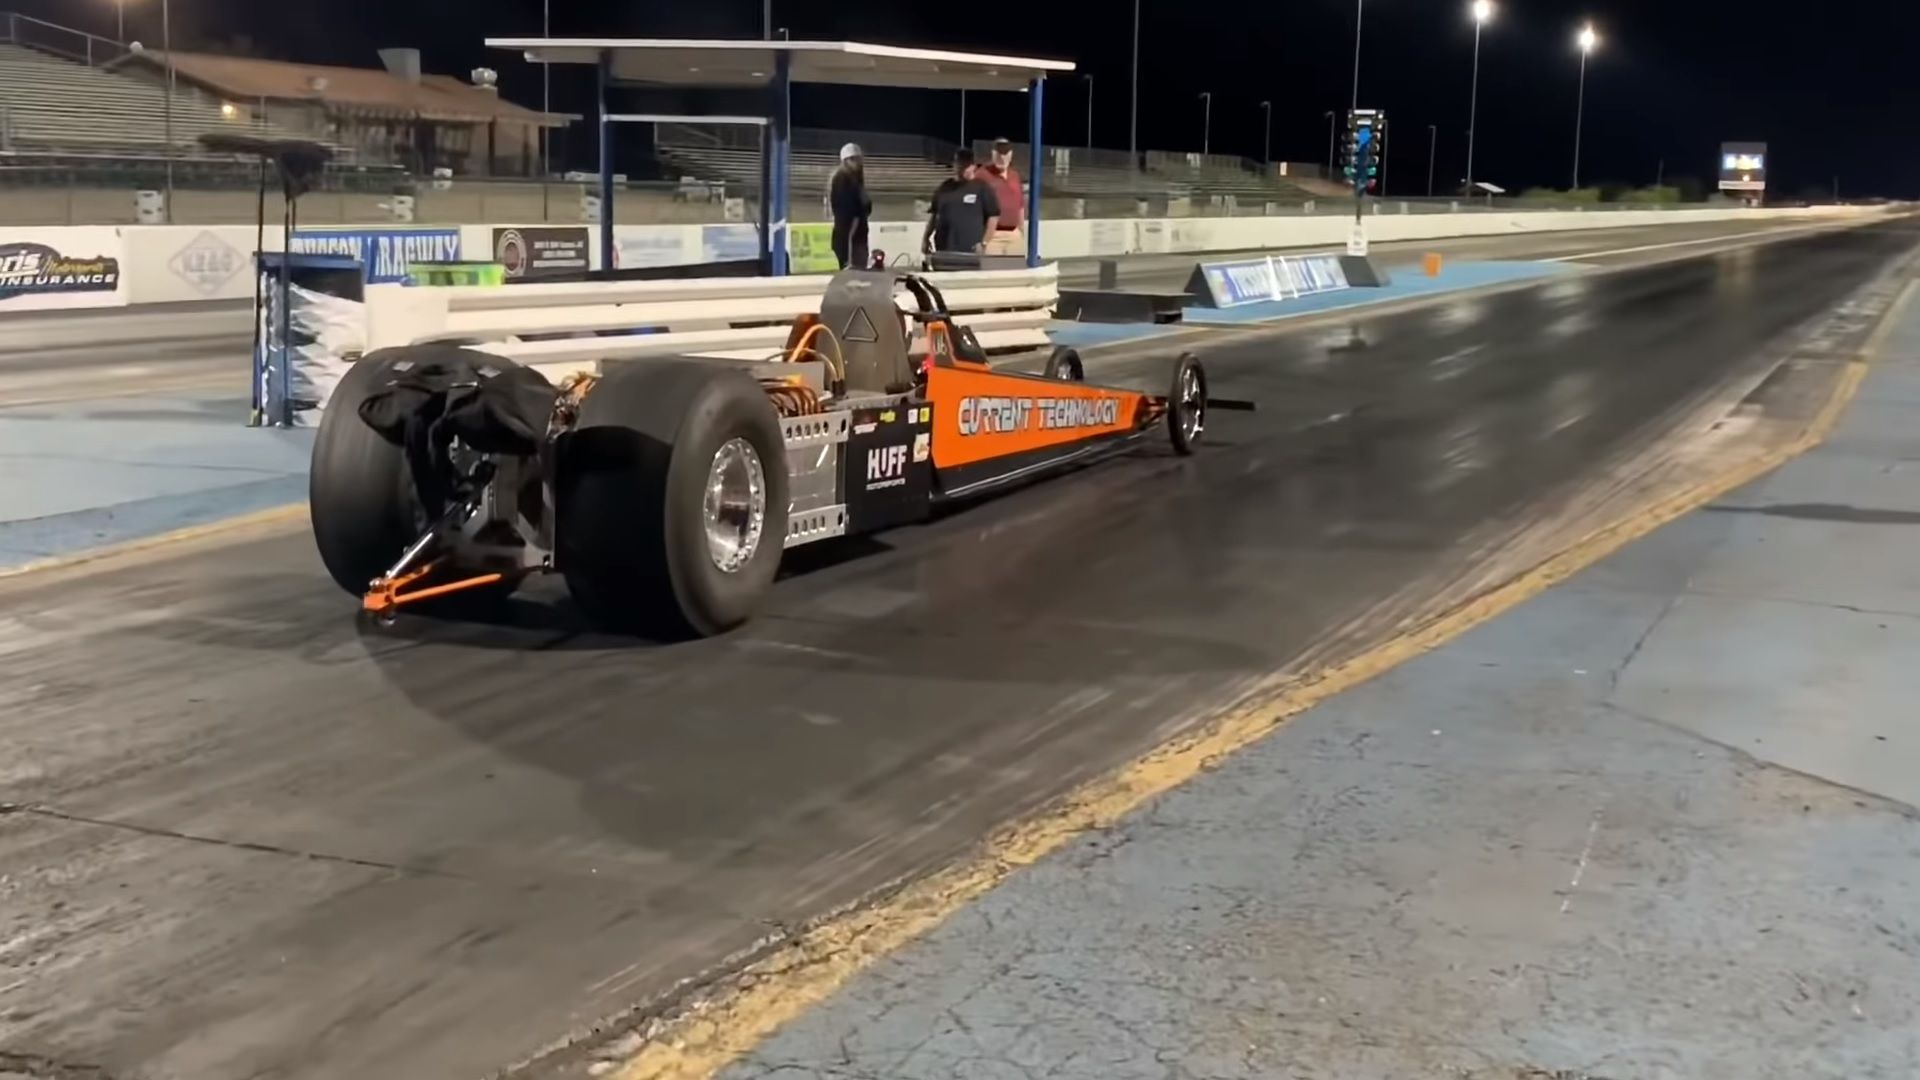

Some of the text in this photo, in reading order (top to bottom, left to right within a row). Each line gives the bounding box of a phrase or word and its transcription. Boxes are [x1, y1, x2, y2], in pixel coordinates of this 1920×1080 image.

[0, 273, 115, 286] INSURANCE
[958, 397, 1120, 435] CURRENT TECHNOLOGY
[867, 445, 908, 480] HUFF
